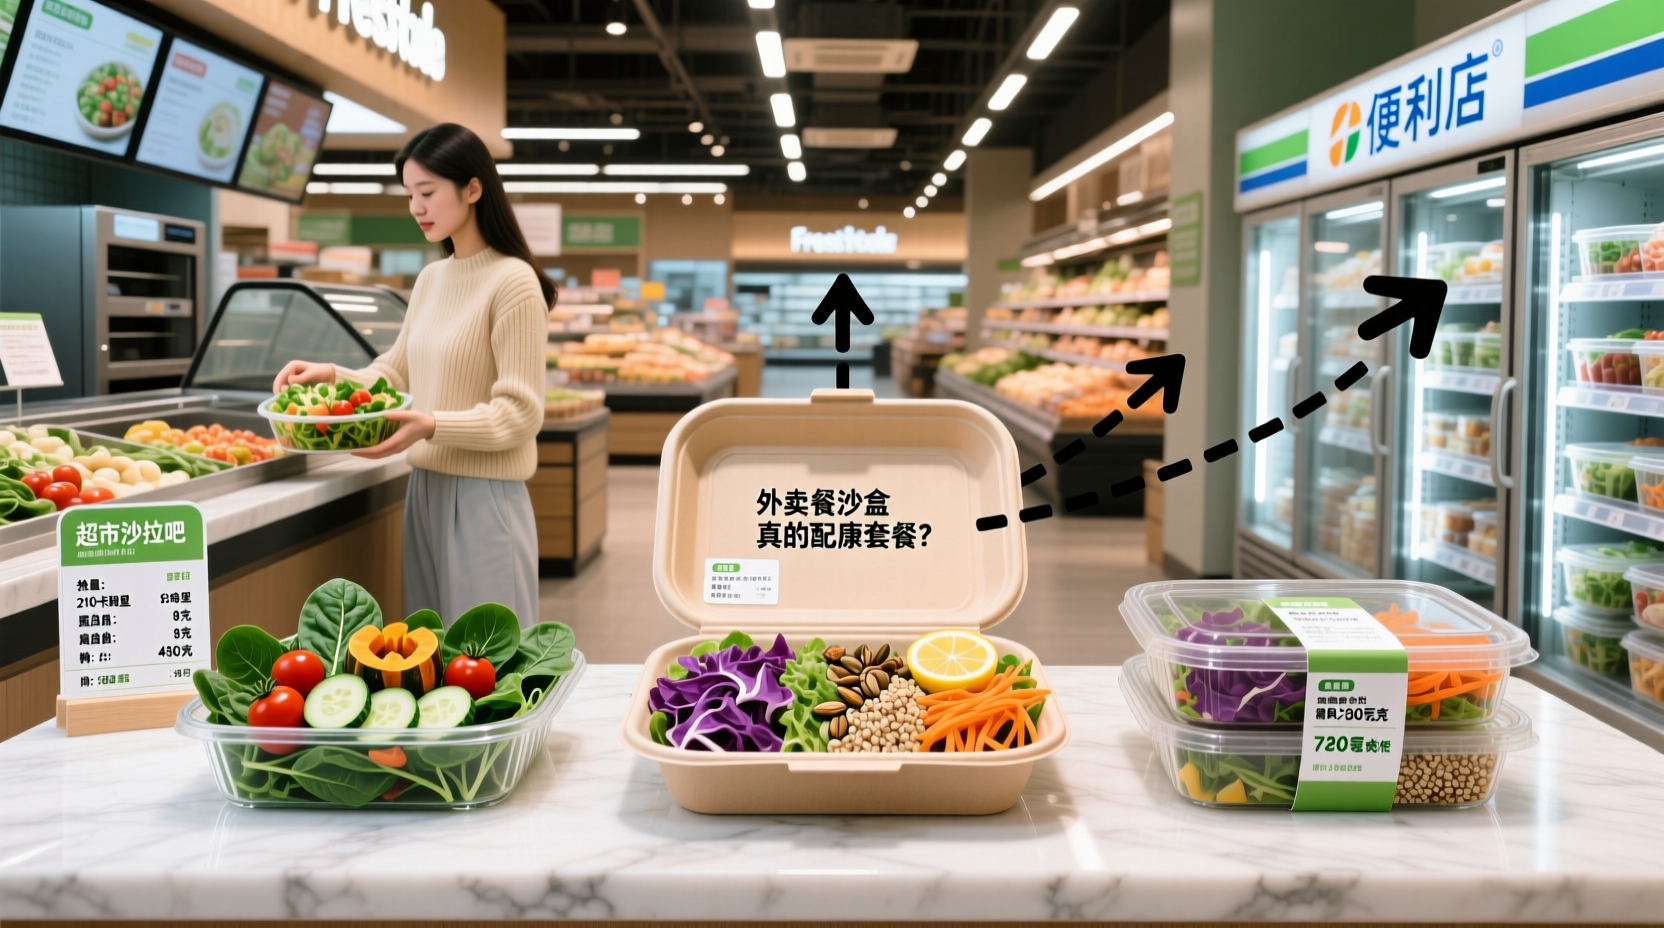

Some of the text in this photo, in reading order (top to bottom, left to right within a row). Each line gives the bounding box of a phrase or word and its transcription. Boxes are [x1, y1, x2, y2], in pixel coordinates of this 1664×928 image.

[1366, 52, 1490, 156] 便利店
[756, 487, 891, 517] 外卖餐沙盒
[75, 520, 186, 547] 超市沙拉吧
